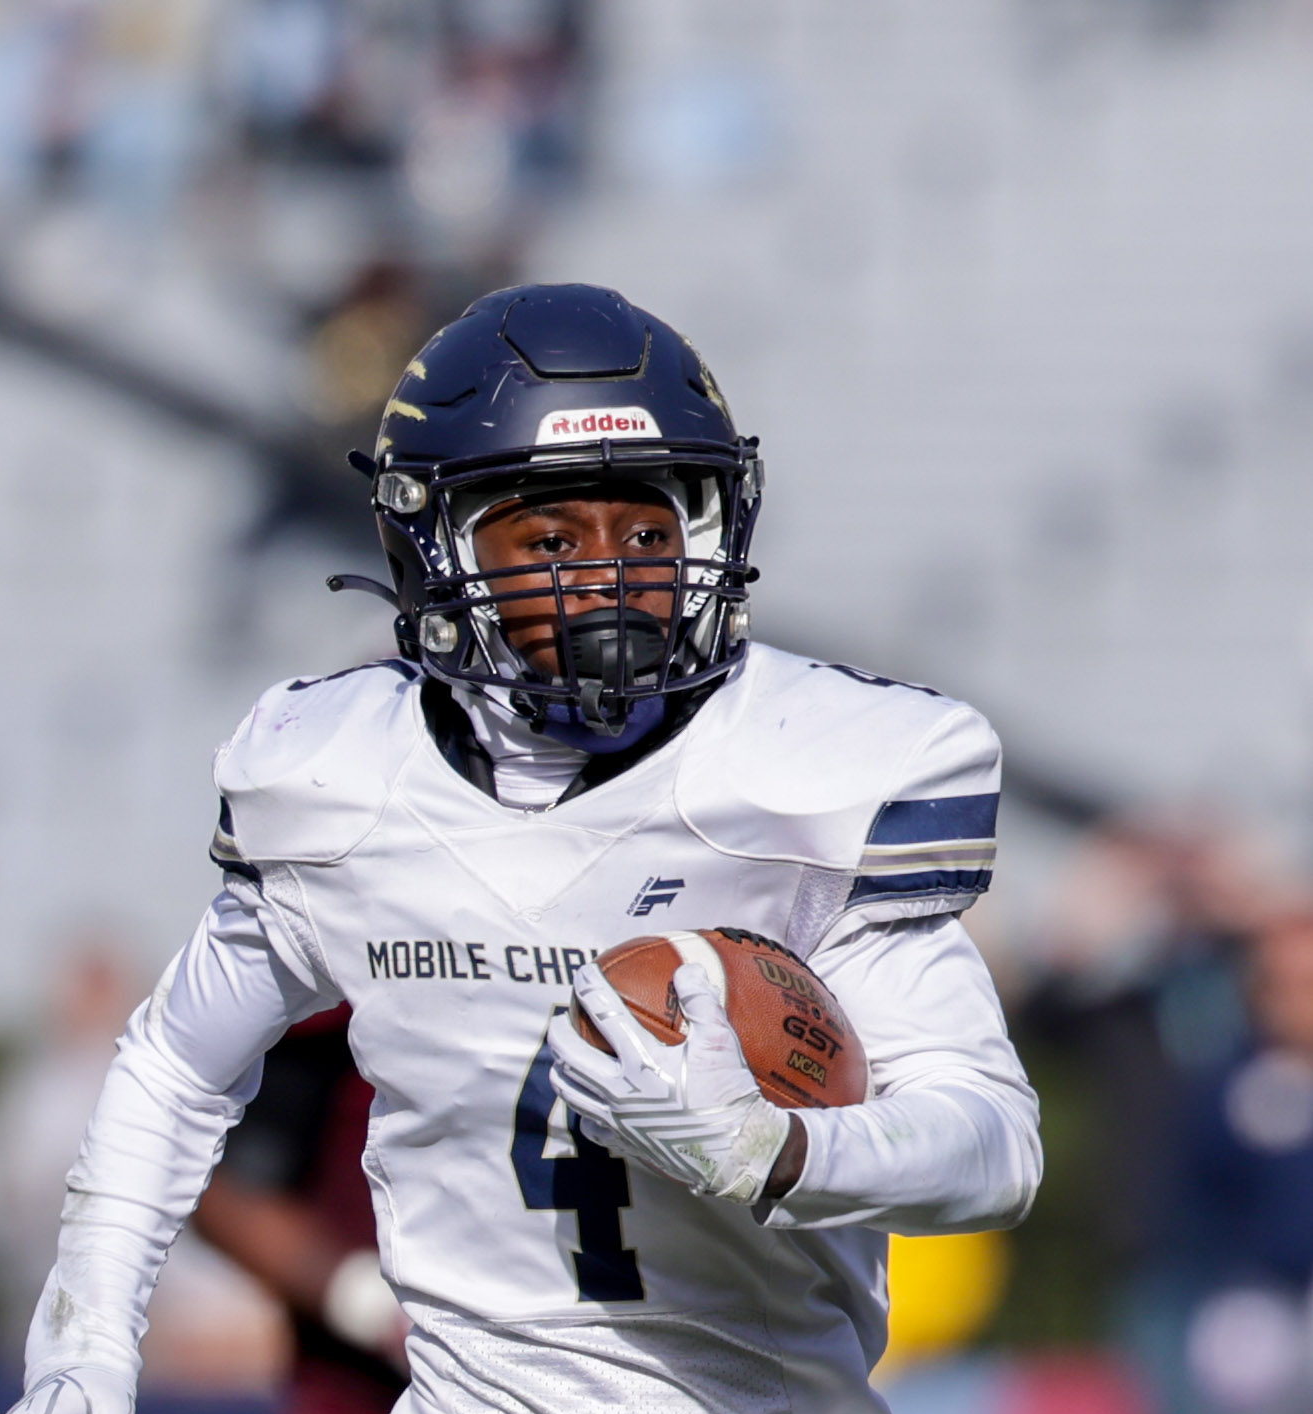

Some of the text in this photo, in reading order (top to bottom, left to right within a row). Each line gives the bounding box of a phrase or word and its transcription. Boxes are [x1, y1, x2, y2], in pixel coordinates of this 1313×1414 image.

[551, 412, 647, 435] Riddell
[366, 940, 599, 987] MOBILE CHR
[782, 1015, 844, 1060] GST
[786, 1050, 828, 1087] NCAA
[509, 1002, 648, 1304] 4
